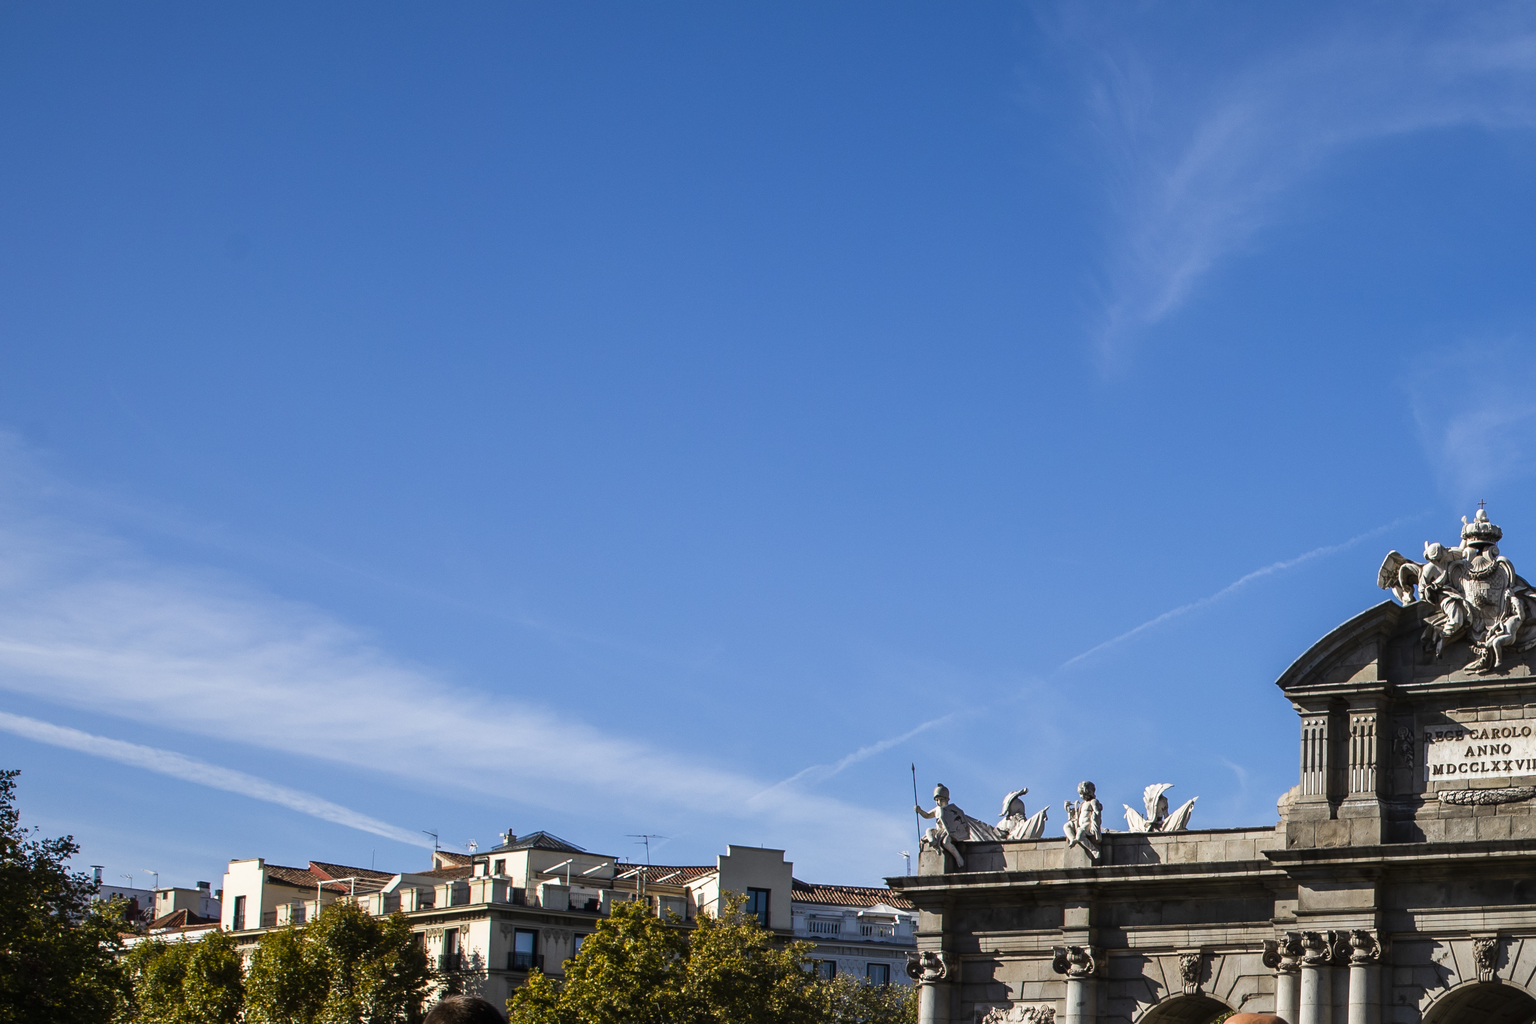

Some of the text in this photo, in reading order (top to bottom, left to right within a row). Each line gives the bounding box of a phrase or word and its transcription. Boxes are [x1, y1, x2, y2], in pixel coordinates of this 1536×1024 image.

[1423, 729, 1465, 744] REGE
[1469, 725, 1532, 740] CAROLO
[1464, 743, 1512, 758] ANNO
